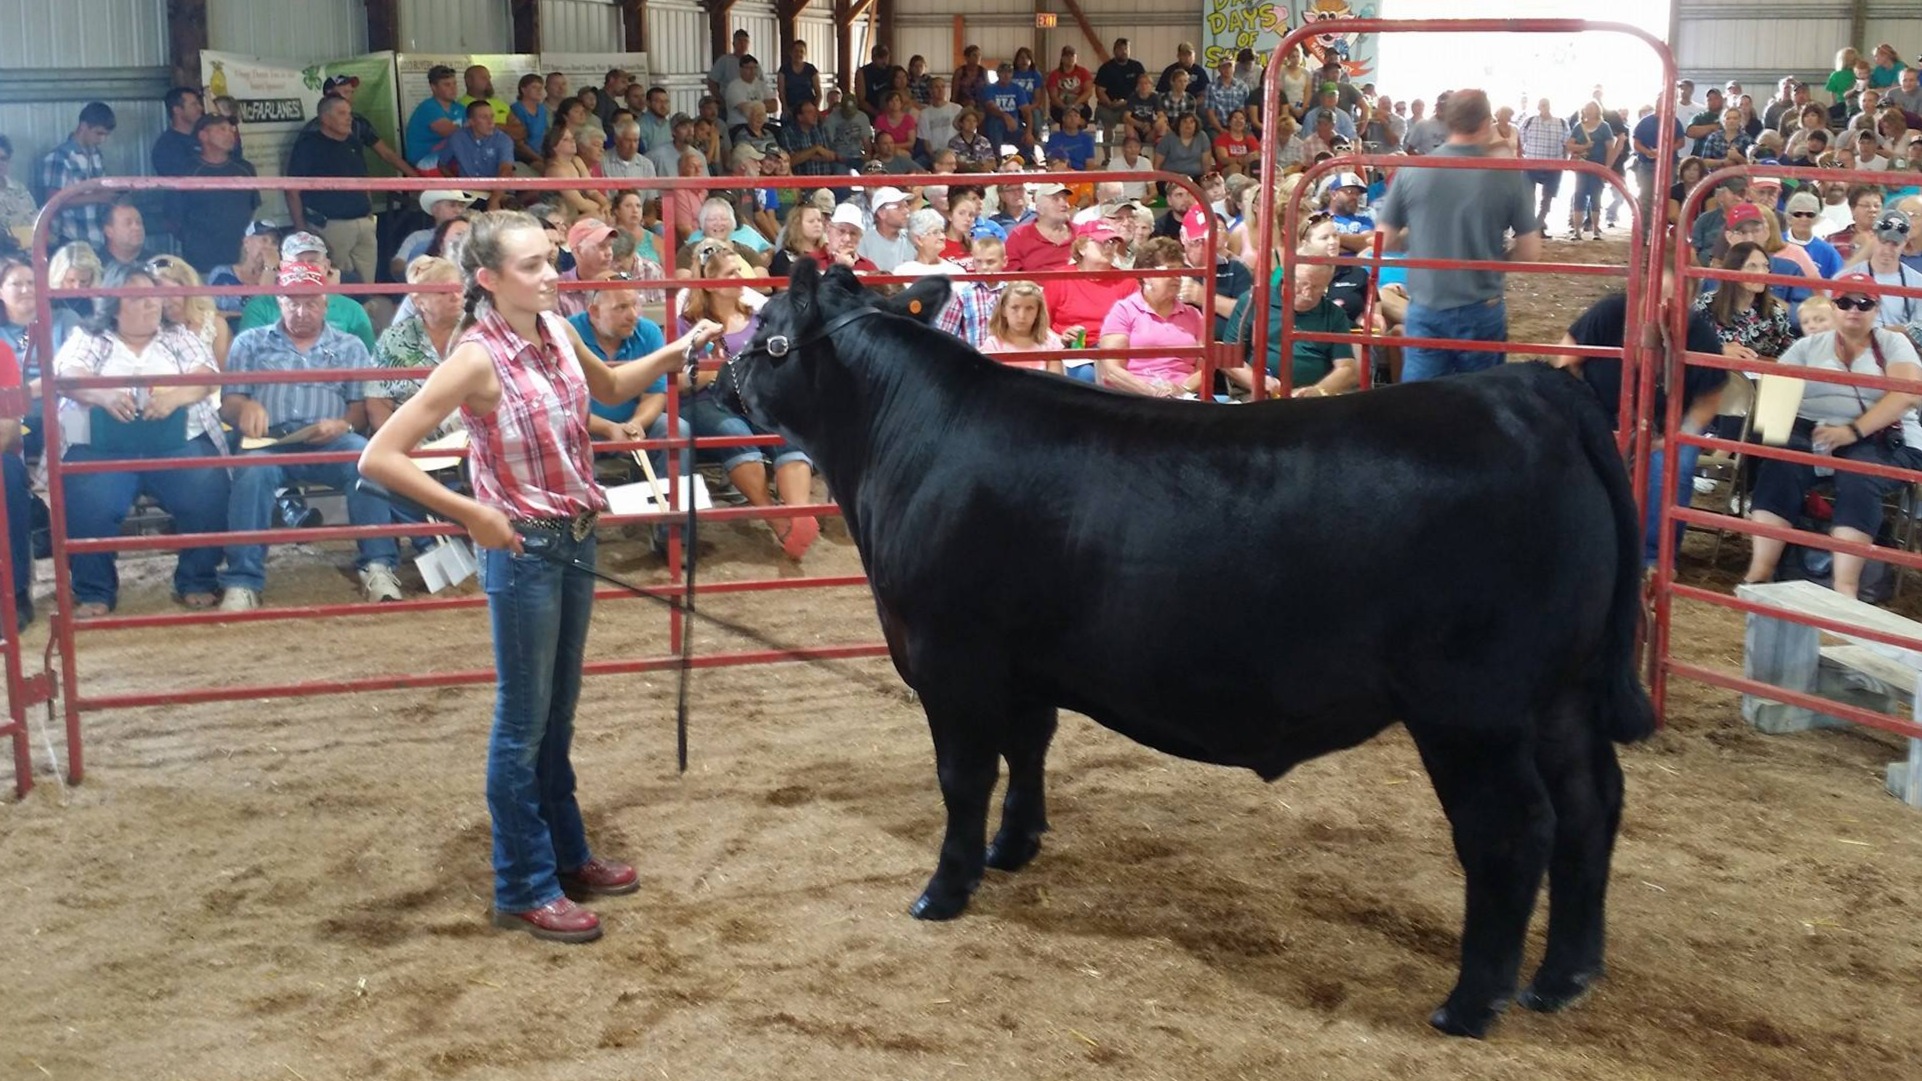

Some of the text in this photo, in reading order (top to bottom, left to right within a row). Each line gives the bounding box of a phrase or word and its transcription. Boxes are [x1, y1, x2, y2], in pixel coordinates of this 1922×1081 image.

[1038, 14, 1055, 27] EXIT
[1207, 3, 1278, 35] DAYS
[1236, 30, 1259, 48] OF
